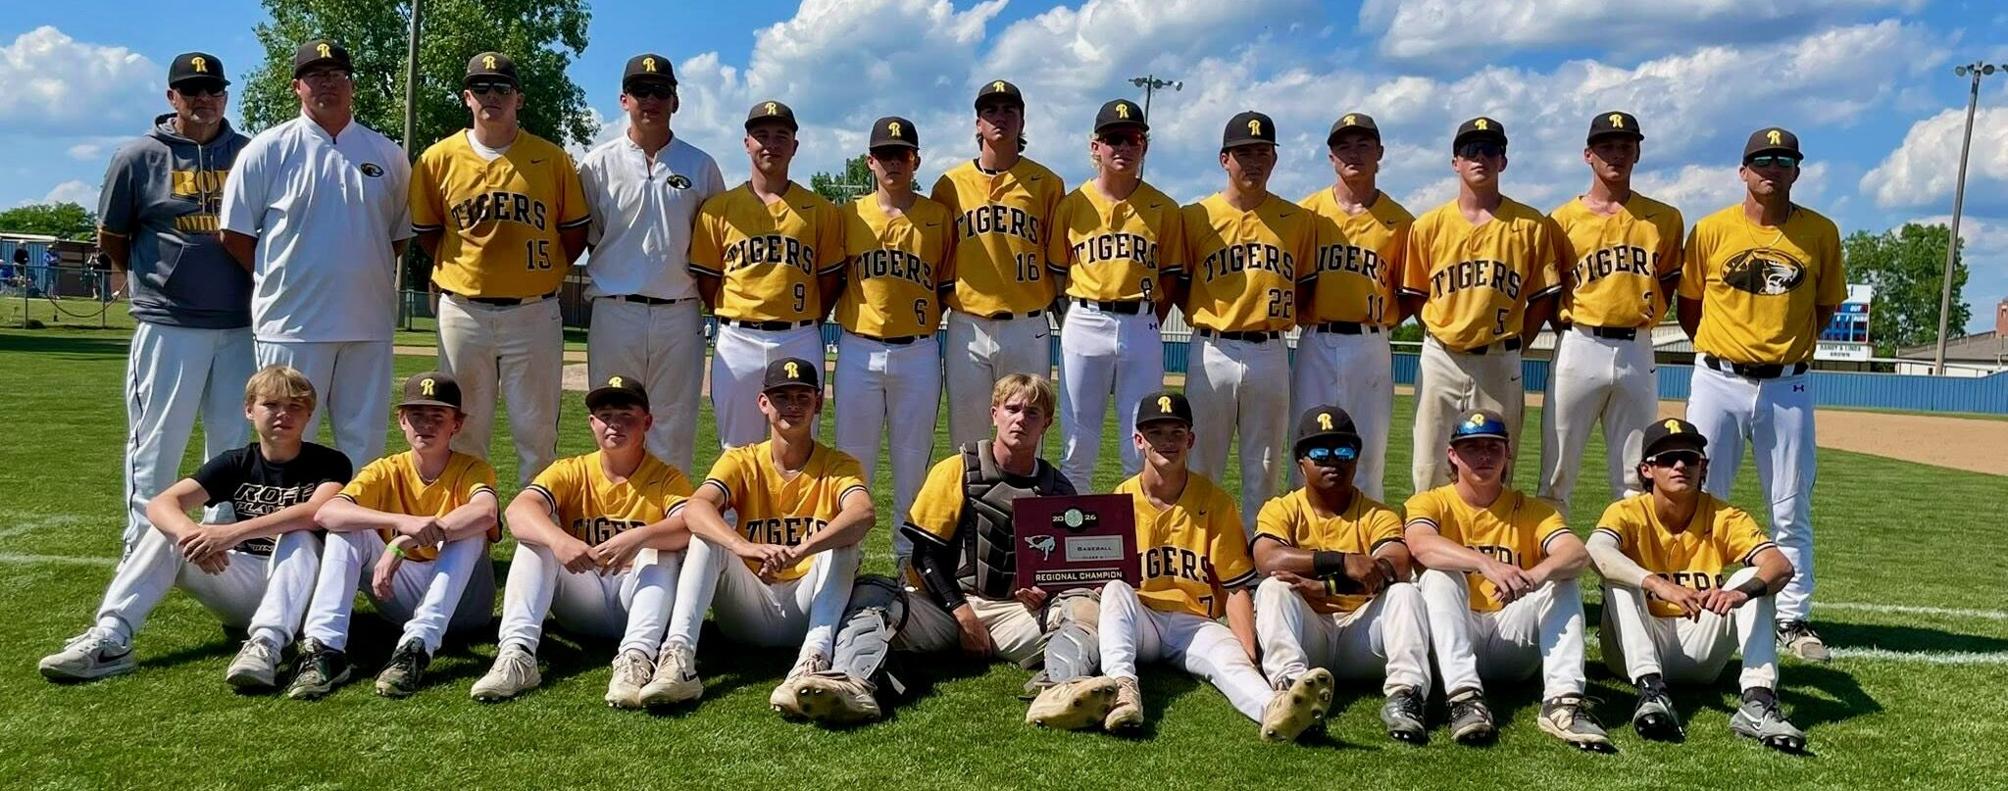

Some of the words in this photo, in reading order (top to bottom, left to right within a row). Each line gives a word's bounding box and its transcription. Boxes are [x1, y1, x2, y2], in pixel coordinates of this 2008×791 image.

[317, 43, 332, 58] R
[192, 57, 208, 73] R
[482, 53, 497, 70] R
[643, 58, 656, 72] R
[993, 81, 1005, 92] R
[765, 103, 777, 115] R
[1116, 103, 1129, 118] R
[889, 121, 901, 137] R
[1248, 120, 1261, 135] R
[1344, 115, 1356, 126] R
[1475, 119, 1488, 130] R
[1609, 113, 1623, 128] R
[1767, 130, 1781, 145] R
[451, 190, 546, 231] TIGERS
[526, 239, 552, 270] 15
[726, 234, 815, 276] TIGERS
[1072, 233, 1159, 269] TIGERS
[854, 249, 936, 291] TIGERS
[1016, 252, 1040, 282] 16
[1203, 242, 1295, 283] TIGERS
[1318, 244, 1388, 288] IGERS
[1430, 260, 1522, 301] TIGERS
[793, 283, 806, 313] 9
[1268, 287, 1294, 319] 22
[1367, 293, 1384, 323] 11
[1492, 307, 1511, 336] 5
[784, 361, 799, 378] R
[421, 376, 435, 395] R
[608, 375, 623, 388] R
[1158, 395, 1173, 413] R
[1318, 413, 1333, 431] R
[1664, 419, 1682, 434] R
[1136, 546, 1211, 583] IGERS
[1036, 572, 1078, 582] REGIONAL
[1079, 570, 1123, 580] CHAMPION
[1199, 595, 1213, 618] 7
